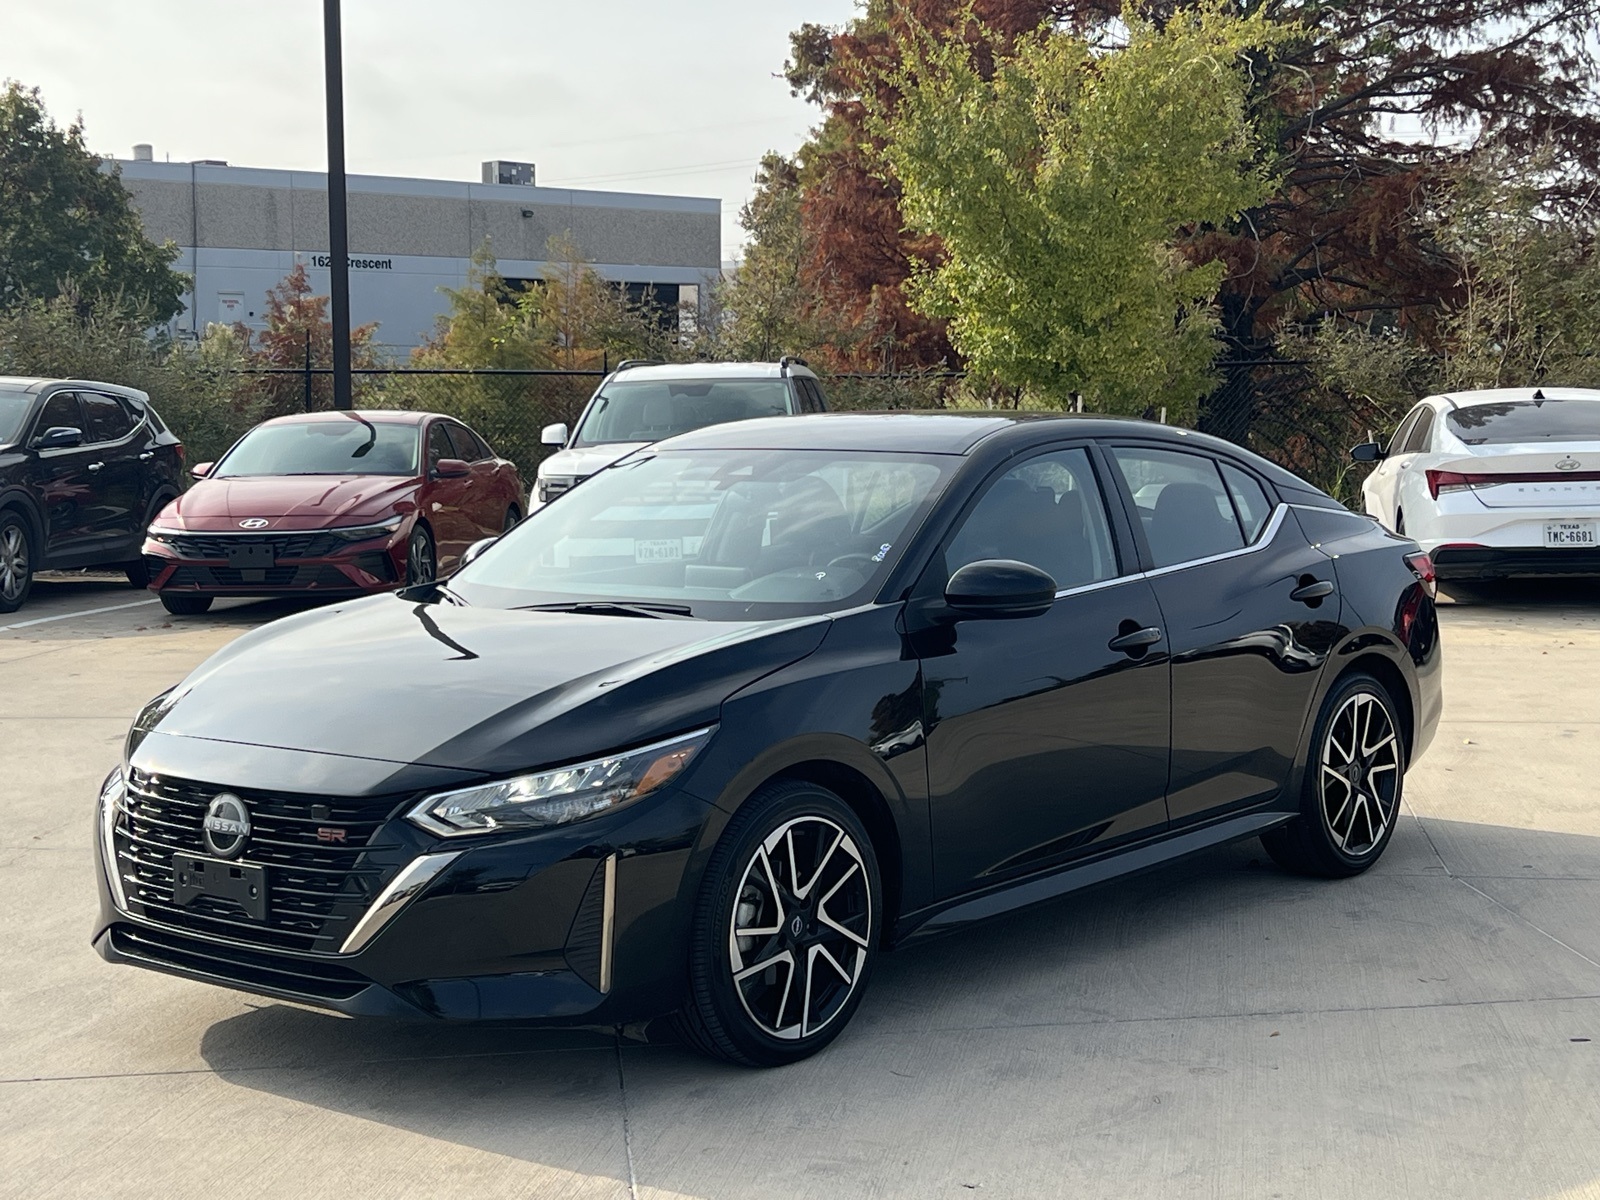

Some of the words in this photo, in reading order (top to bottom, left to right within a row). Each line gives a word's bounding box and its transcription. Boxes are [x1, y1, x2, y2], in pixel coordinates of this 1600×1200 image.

[311, 255, 332, 267] 162
[203, 818, 248, 834] NISSAN
[317, 827, 347, 843] SR
